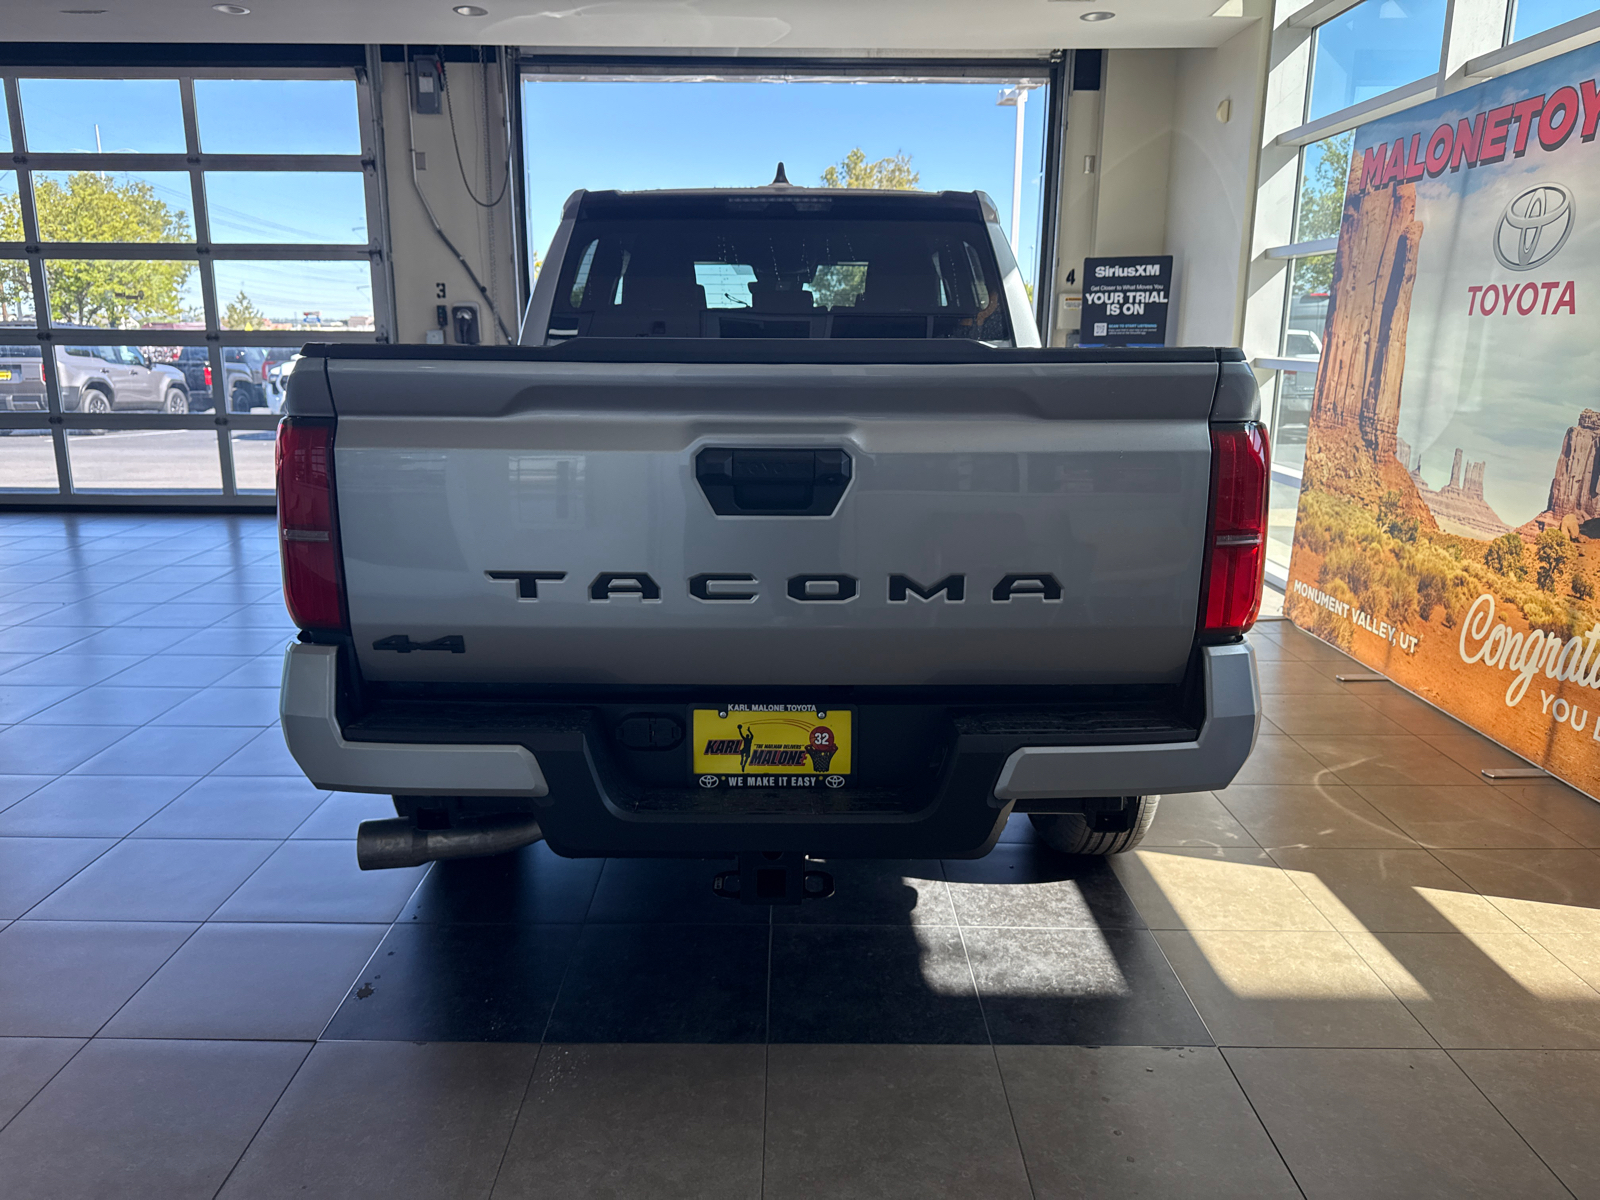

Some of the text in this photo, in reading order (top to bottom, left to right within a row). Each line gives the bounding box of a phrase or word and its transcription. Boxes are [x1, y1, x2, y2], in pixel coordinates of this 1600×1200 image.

[1066, 268, 1076, 286] 4
[1095, 264, 1160, 278] SiriusXM
[436, 282, 446, 298] 3
[1085, 292, 1124, 304] YOUR
[1126, 291, 1168, 303] TRIAL
[1467, 280, 1576, 317] TOYOTA
[1106, 303, 1145, 316] IS ON
[484, 570, 1064, 604] TACOMA
[1293, 580, 1419, 654] MONUMENT VALLEY, UT
[727, 704, 817, 712] KARL MALONE TOYOTA
[1540, 689, 1588, 732] YOU
[814, 732, 829, 745] 32
[704, 739, 743, 756] KARL
[749, 749, 807, 767] MALONE
[728, 777, 817, 787] WE MAKE IT EASY
